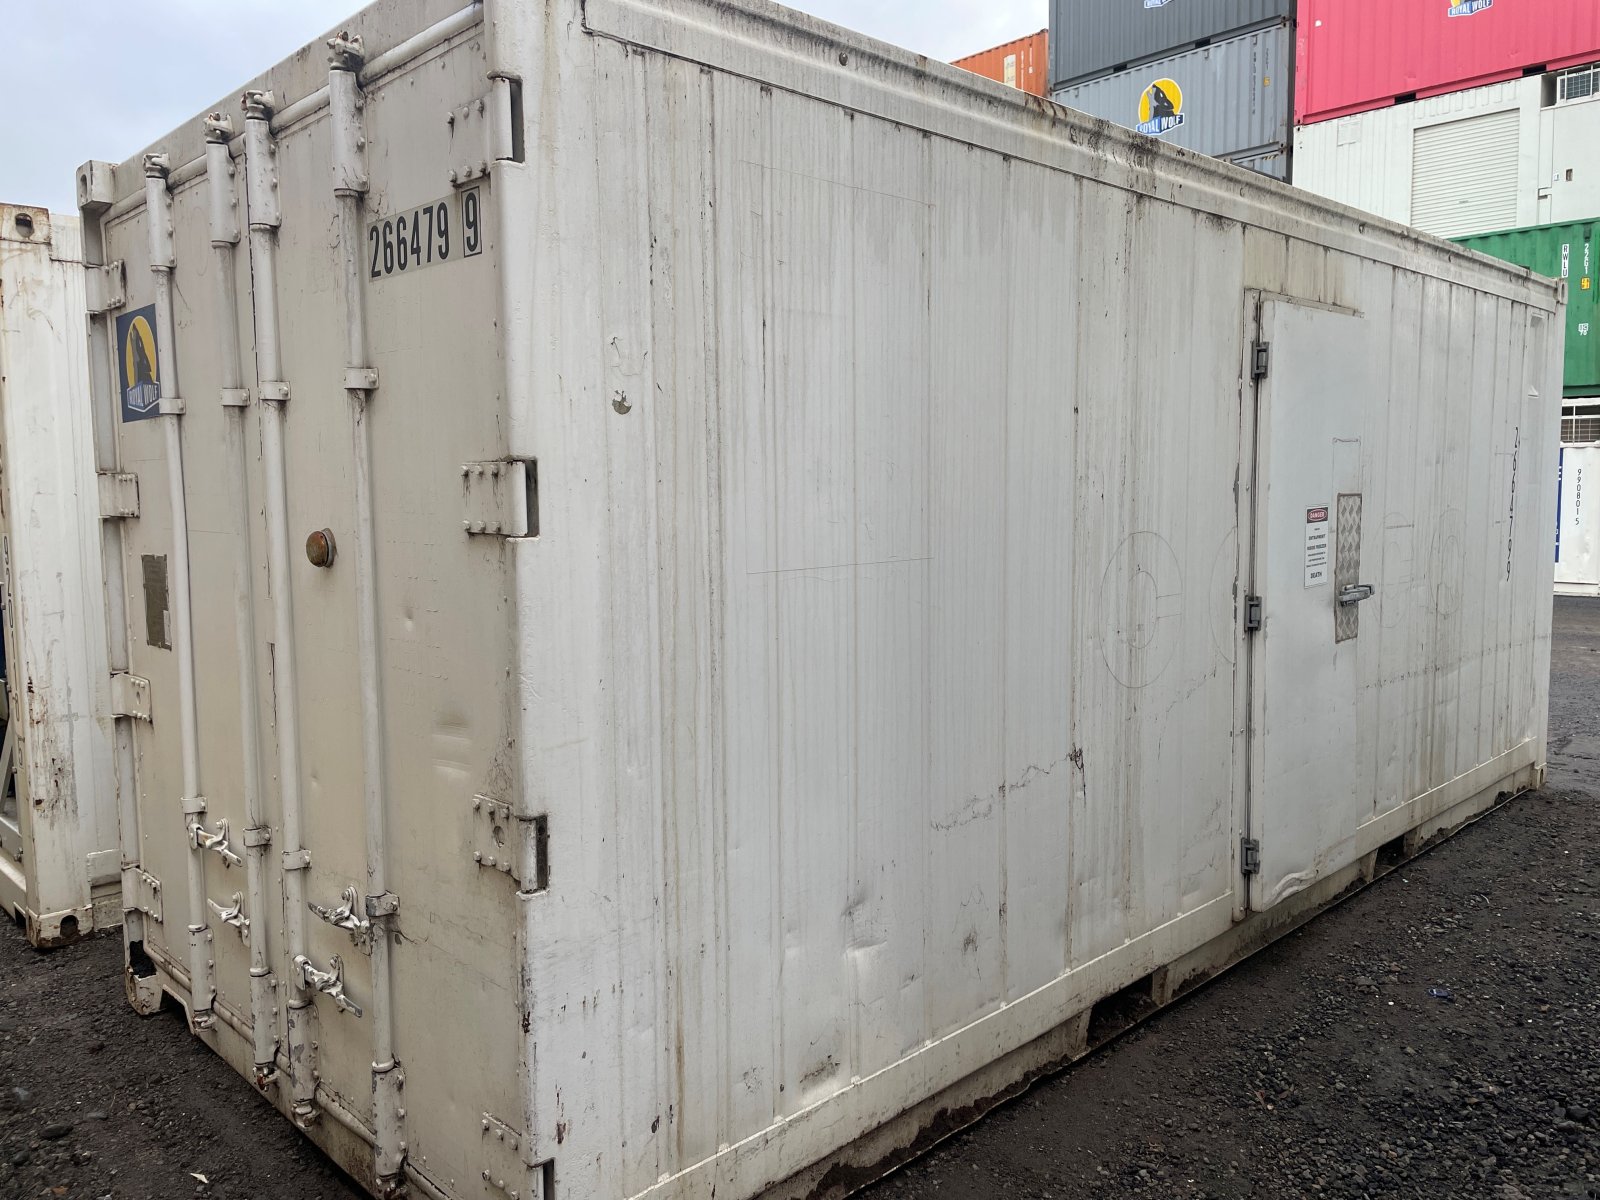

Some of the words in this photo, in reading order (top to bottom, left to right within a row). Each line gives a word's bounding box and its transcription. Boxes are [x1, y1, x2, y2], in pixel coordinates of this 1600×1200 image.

[1451, 1, 1471, 16] ROYAL
[1161, 116, 1181, 131] WOLF
[369, 202, 450, 278] 266479
[464, 192, 479, 252] 9
[129, 385, 144, 407] ROYAL
[144, 384, 158, 406] WOLF
